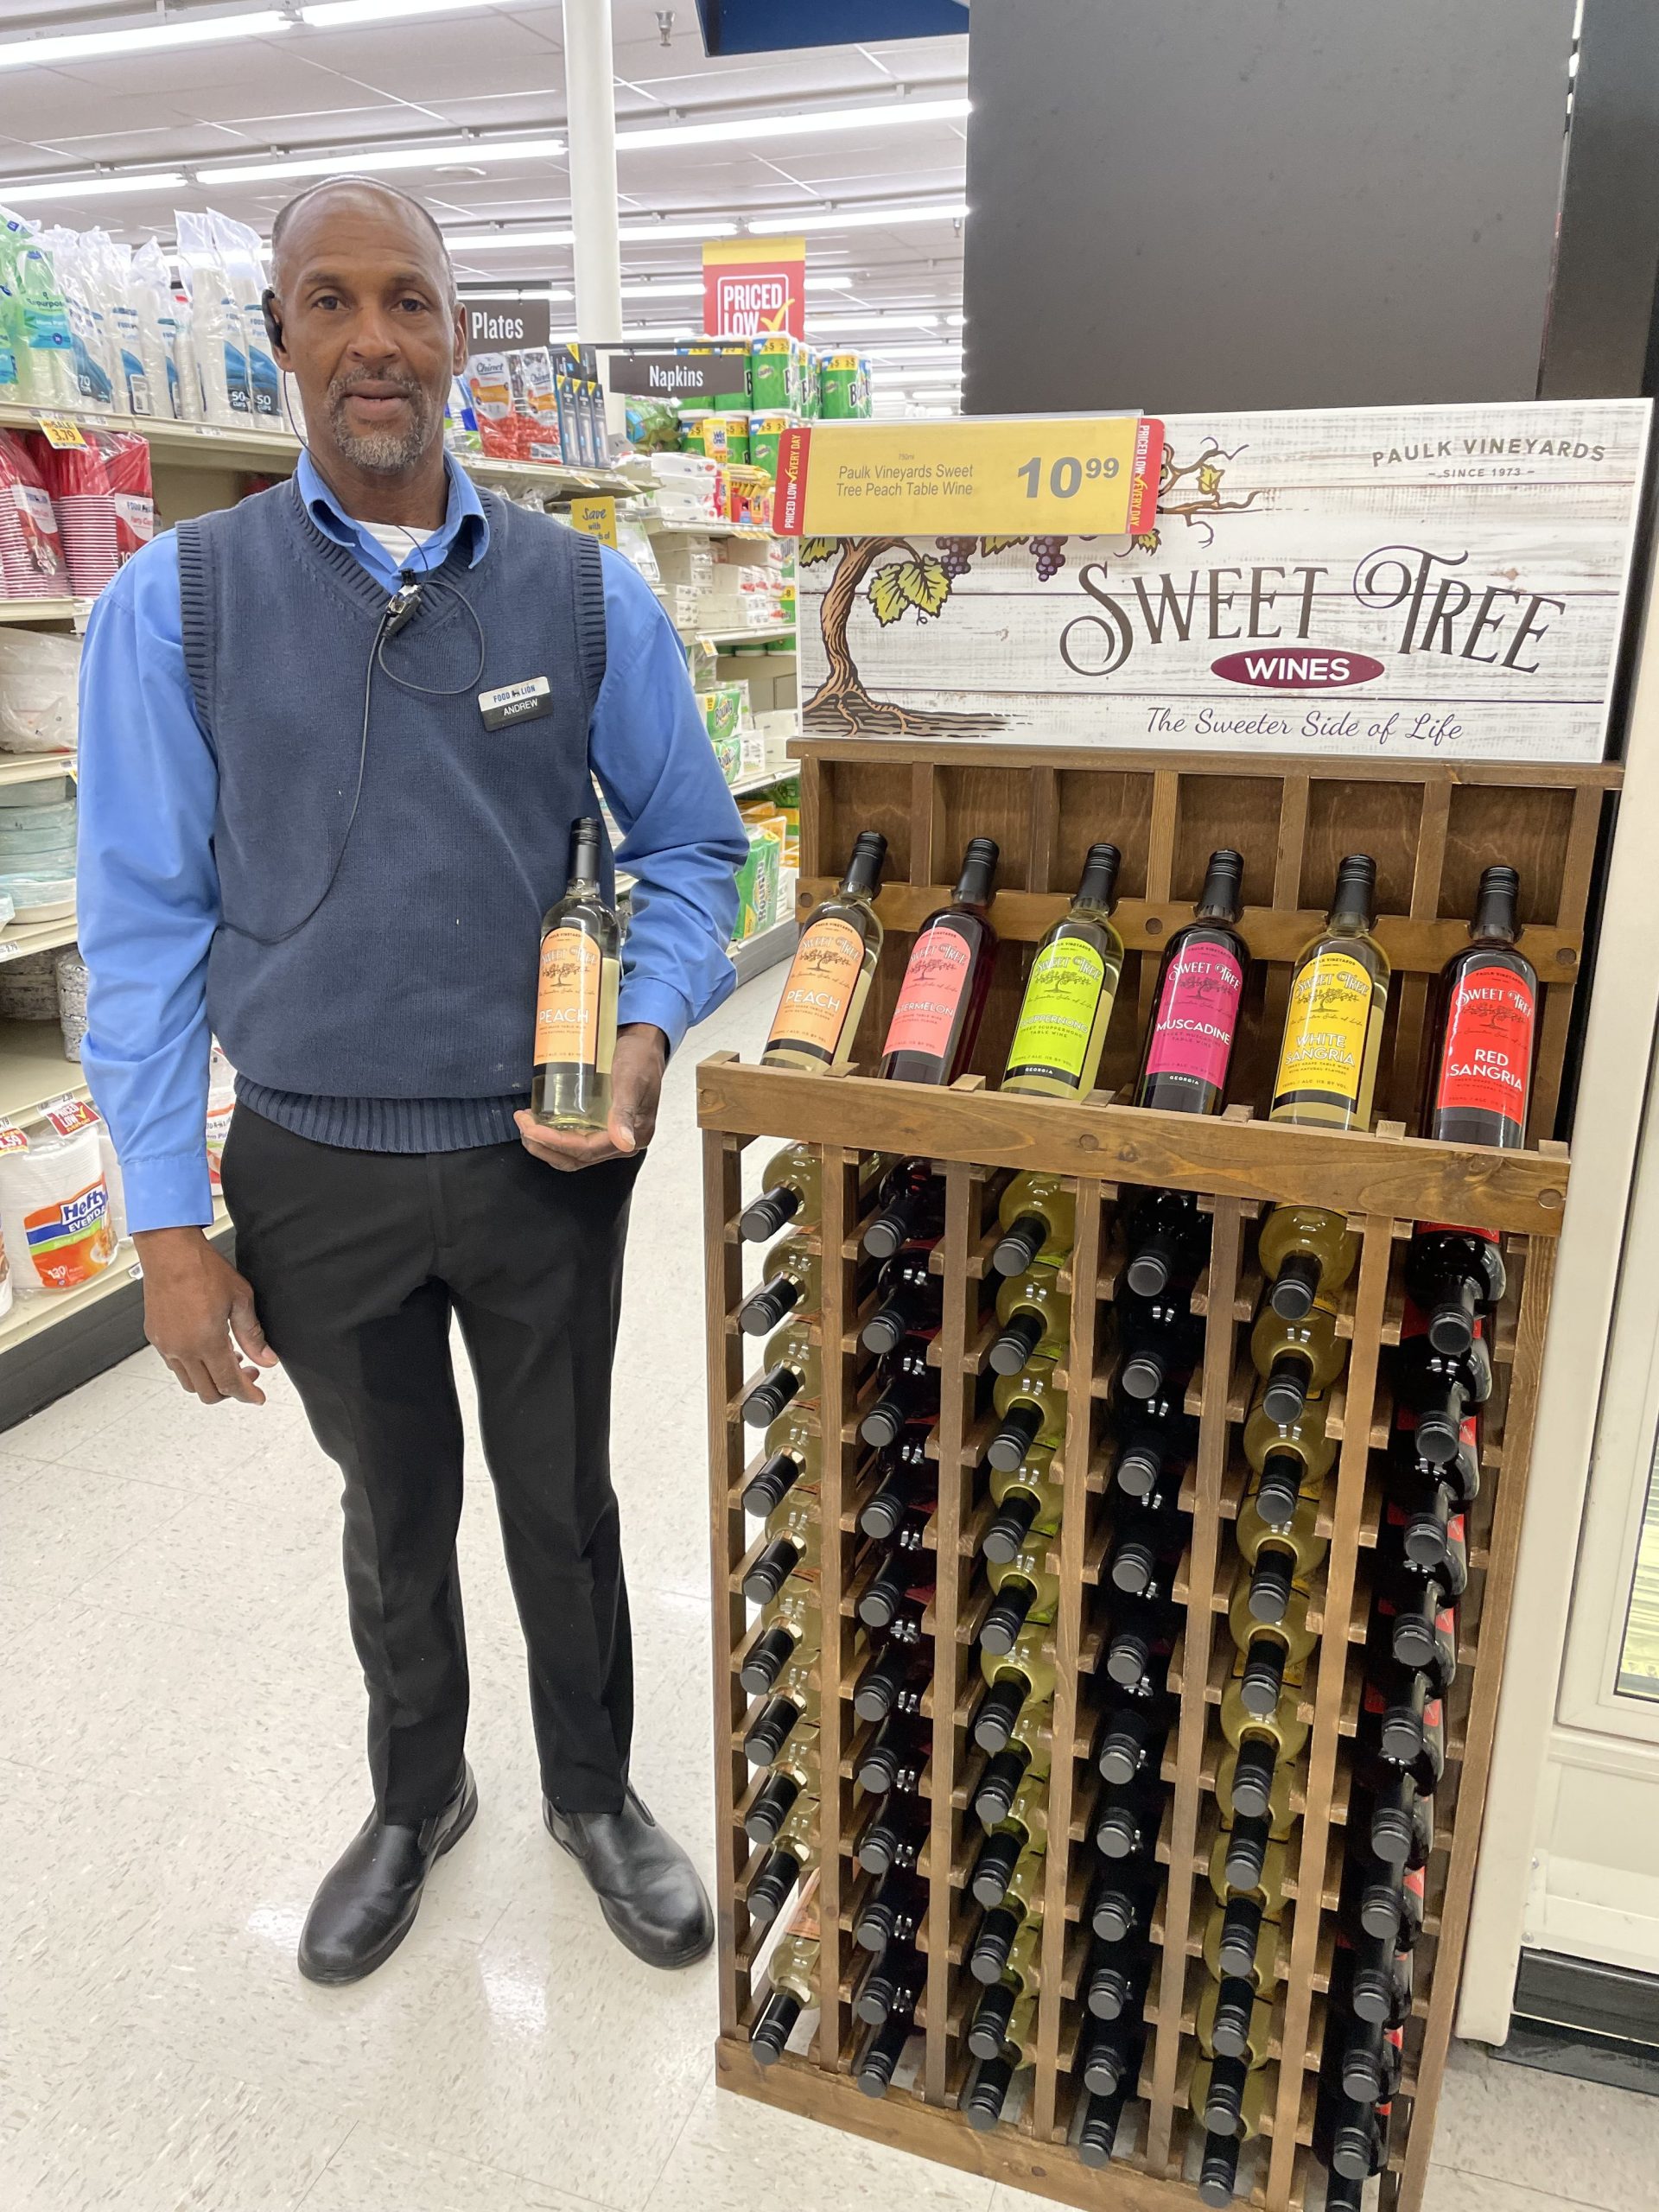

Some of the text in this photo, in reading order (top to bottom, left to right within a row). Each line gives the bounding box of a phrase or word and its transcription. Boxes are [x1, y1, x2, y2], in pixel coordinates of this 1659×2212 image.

[724, 283, 782, 311] PRICED
[472, 312, 524, 340] Plates
[724, 311, 760, 336] LOW
[476, 362, 504, 373] Chinet
[650, 365, 703, 391] Napkins
[232, 391, 246, 401] 50
[257, 395, 271, 405] 50
[52, 429, 76, 441] 3.79
[791, 434, 801, 449] DAY
[789, 450, 800, 474] EVERY
[1372, 438, 1606, 467] PAULK VINEYARDS
[839, 464, 974, 481] Paulk Vineyards Sweet
[1129, 425, 1150, 526] PRICED LOW EVERY DAY
[1442, 467, 1522, 478] SINCE 1973
[787, 482, 798, 499] LOW
[836, 481, 973, 496] Tree Peach Table Wine
[582, 508, 607, 520] Save
[785, 501, 796, 529] PRICED
[1059, 545, 1566, 677] SWEET TREE
[1244, 658, 1351, 681] WINES
[493, 684, 536, 703] FOOD LION
[504, 698, 538, 716] ANDREW
[1147, 707, 1464, 747] The Sweeter Side of Life
[1168, 962, 1241, 991] SWEET TREE
[785, 988, 841, 1012] PEACH
[1455, 988, 1532, 1017] SWEET TREE
[539, 1007, 589, 1024] PEACH
[1156, 1020, 1230, 1046] MUSCADINE
[1297, 1033, 1346, 1048] WHITE
[1285, 1046, 1355, 1067] SANGRIA
[1475, 1049, 1509, 1066] RED
[1169, 1075, 1199, 1085] GEORGIA
[1450, 1065, 1522, 1091] SANGRIA
[60, 1114, 79, 1128] LOW
[62, 1190, 105, 1221] Hefty
[48, 1265, 67, 1279] 130
